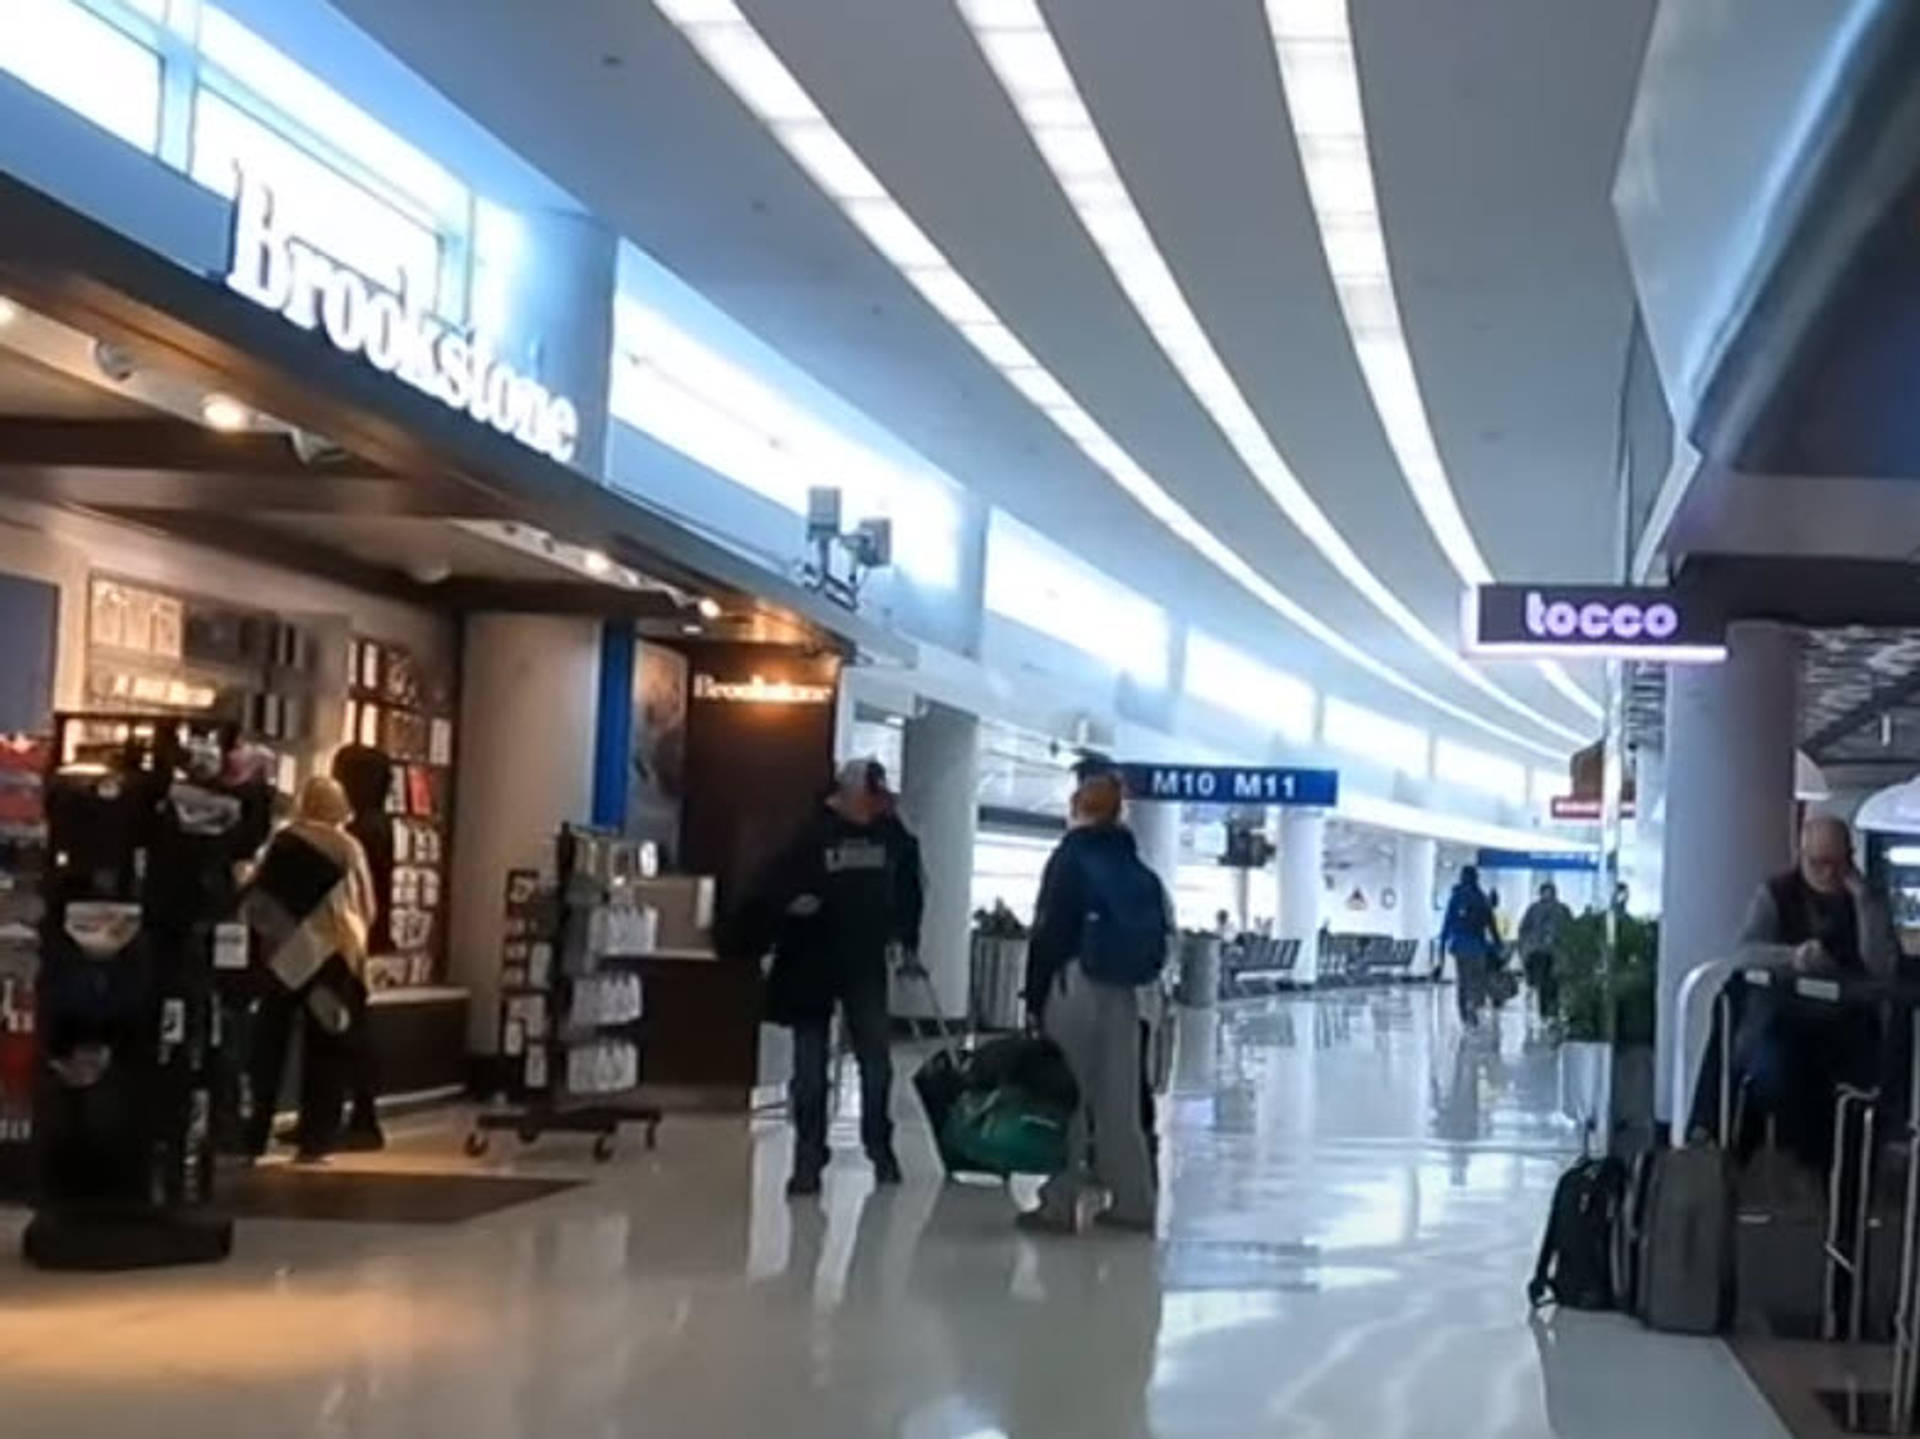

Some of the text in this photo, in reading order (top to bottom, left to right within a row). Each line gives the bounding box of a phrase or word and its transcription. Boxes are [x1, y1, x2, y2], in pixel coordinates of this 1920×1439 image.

[226, 158, 579, 464] Brookstone
[1526, 591, 1678, 638] tocco
[1152, 770, 1295, 797] M10 M11
